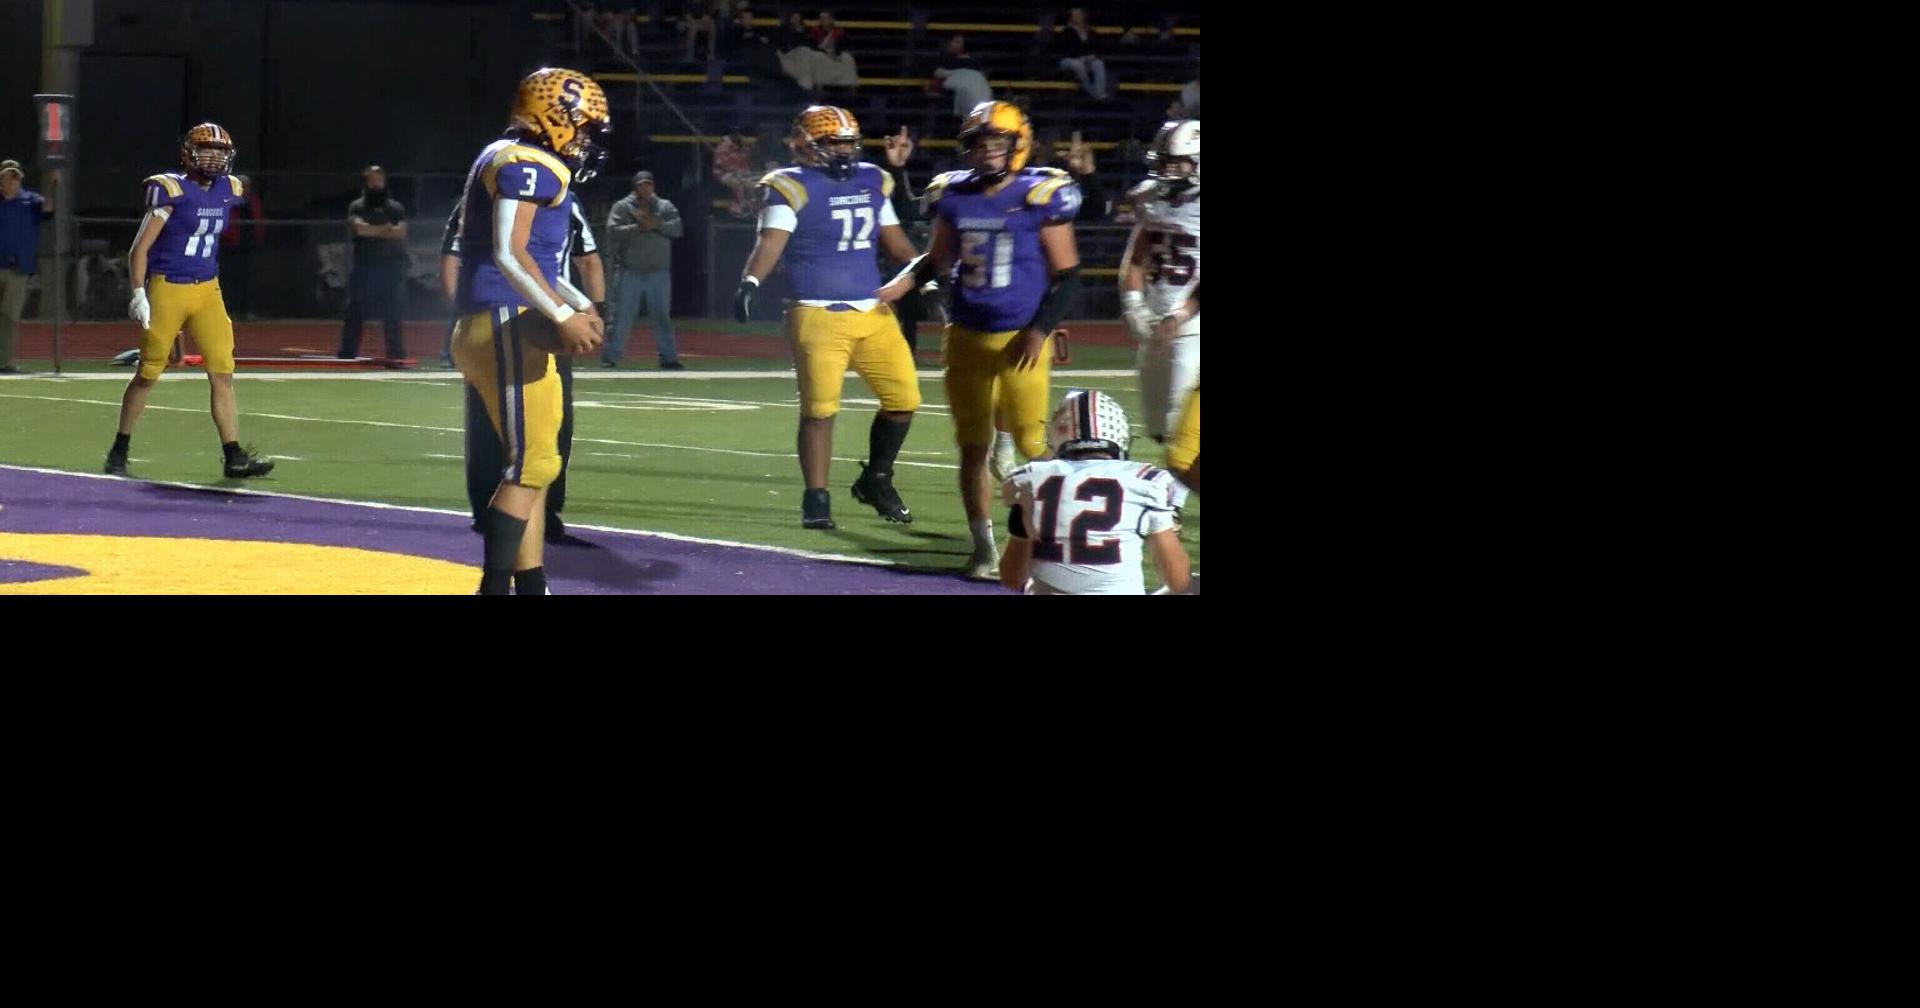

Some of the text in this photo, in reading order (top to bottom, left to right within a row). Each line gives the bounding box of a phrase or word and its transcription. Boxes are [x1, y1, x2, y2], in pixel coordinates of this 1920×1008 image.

[519, 167, 538, 196] 3
[184, 218, 224, 257] 11
[831, 207, 874, 251] 72
[961, 231, 1014, 288] 51
[1032, 475, 1124, 565] 12
